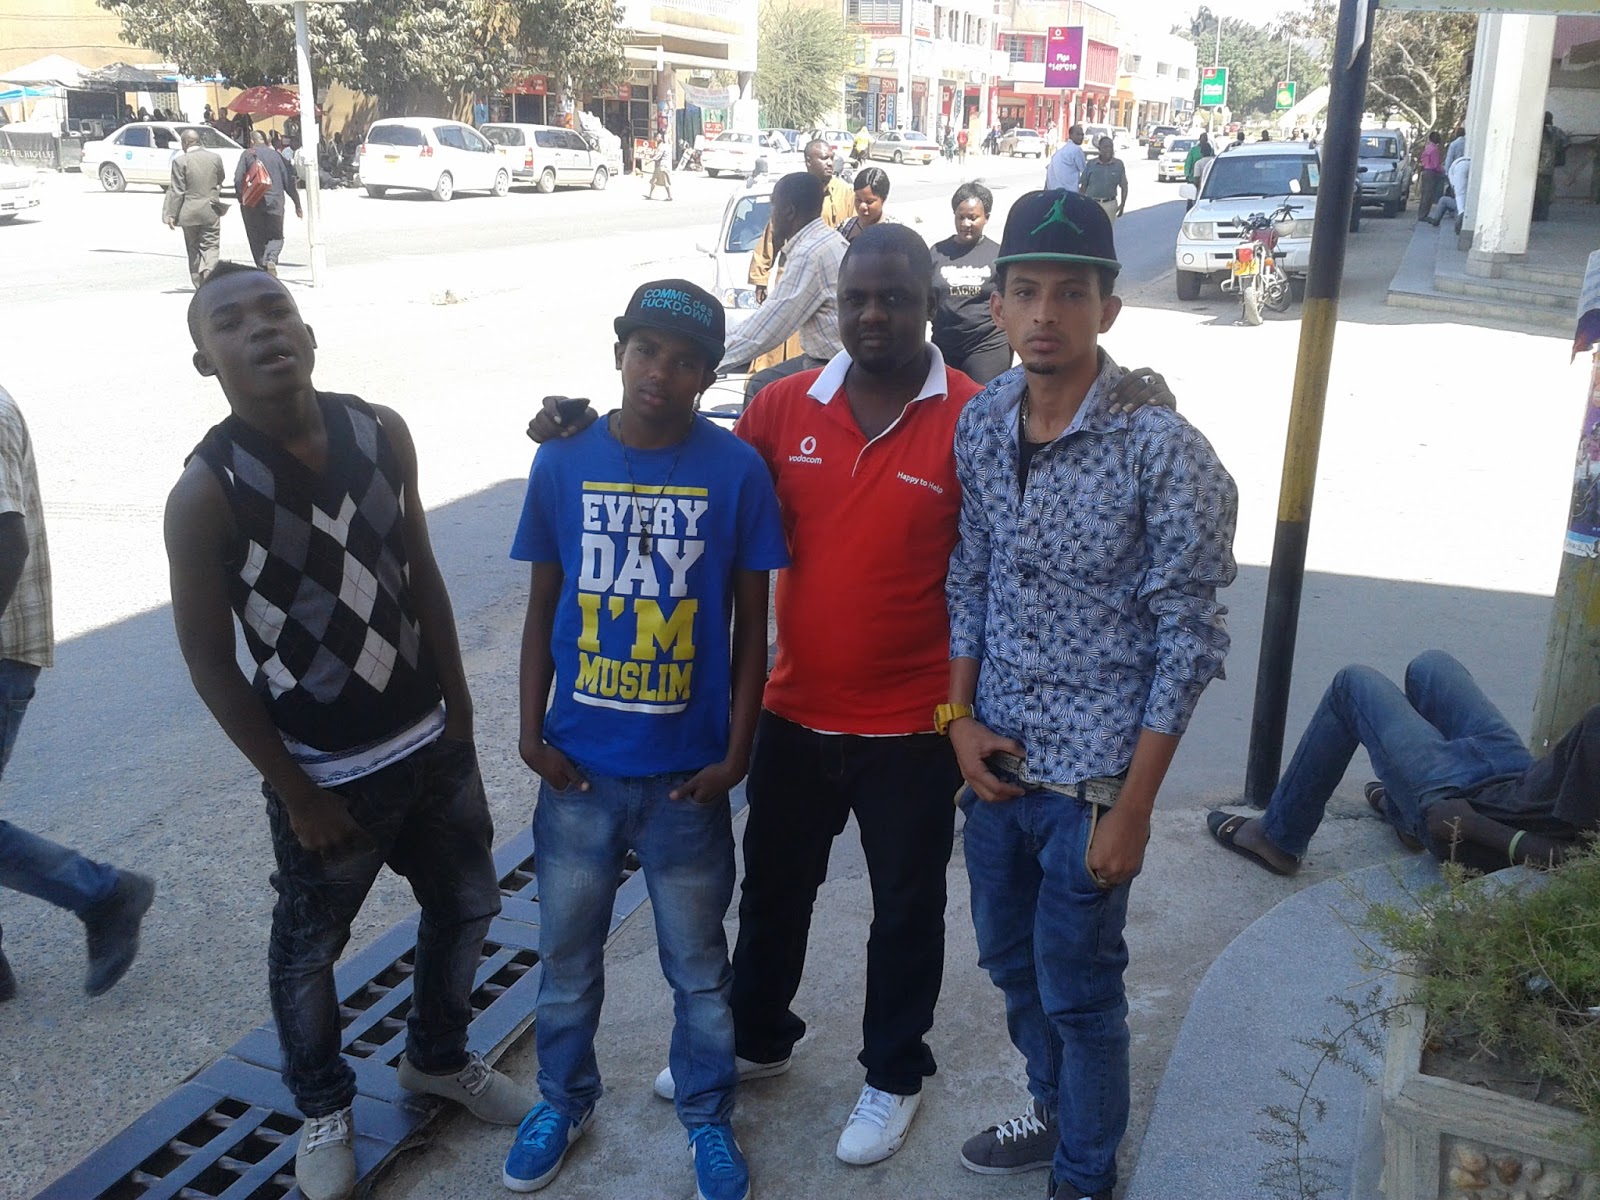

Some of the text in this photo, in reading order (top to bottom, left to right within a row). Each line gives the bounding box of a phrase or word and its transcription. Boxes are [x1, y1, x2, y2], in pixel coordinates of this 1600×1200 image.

[640, 298, 712, 327] FUCKDOWN
[644, 288, 713, 317] COMME des
[788, 455, 822, 464] vodacom
[897, 471, 944, 494] Happy to Help
[582, 493, 708, 537] EVERY
[578, 532, 705, 597] DAY
[577, 592, 698, 660] I'M
[575, 651, 693, 702] MUSLIM
